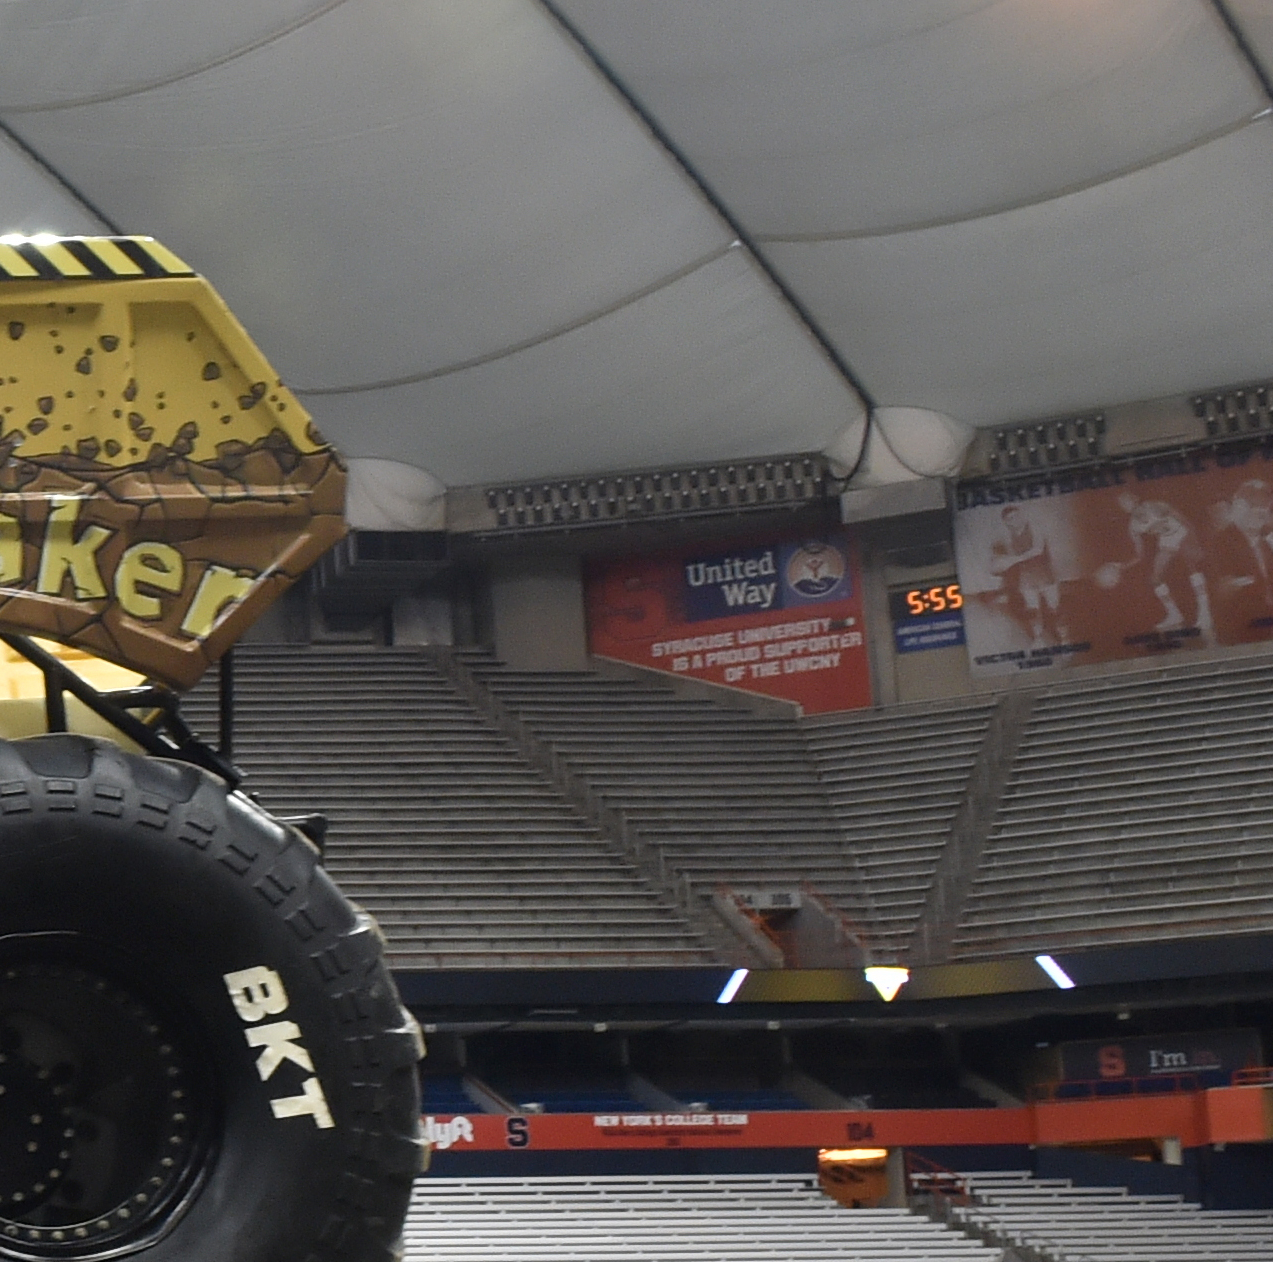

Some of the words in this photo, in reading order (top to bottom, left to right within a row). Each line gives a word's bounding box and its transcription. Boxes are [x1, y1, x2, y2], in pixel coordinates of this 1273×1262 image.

[686, 552, 776, 587] United
[720, 582, 777, 608] Way
[907, 584, 963, 615] 5:55
[651, 631, 735, 657] SYRACUSE
[737, 617, 831, 643] UNIVERSITY
[692, 654, 704, 670] A
[706, 647, 761, 667] PROUD
[764, 632, 863, 658] SUPPORTER
[724, 667, 746, 682] OF
[752, 661, 781, 678] THE
[223, 966, 335, 1130] BKT
[1150, 1049, 1187, 1068] I'm
[505, 1116, 530, 1148] S
[593, 1115, 619, 1127] NEW
[622, 1115, 663, 1126] YORK'S
[664, 1114, 715, 1126] COLLEGE
[716, 1114, 749, 1126] TEAM
